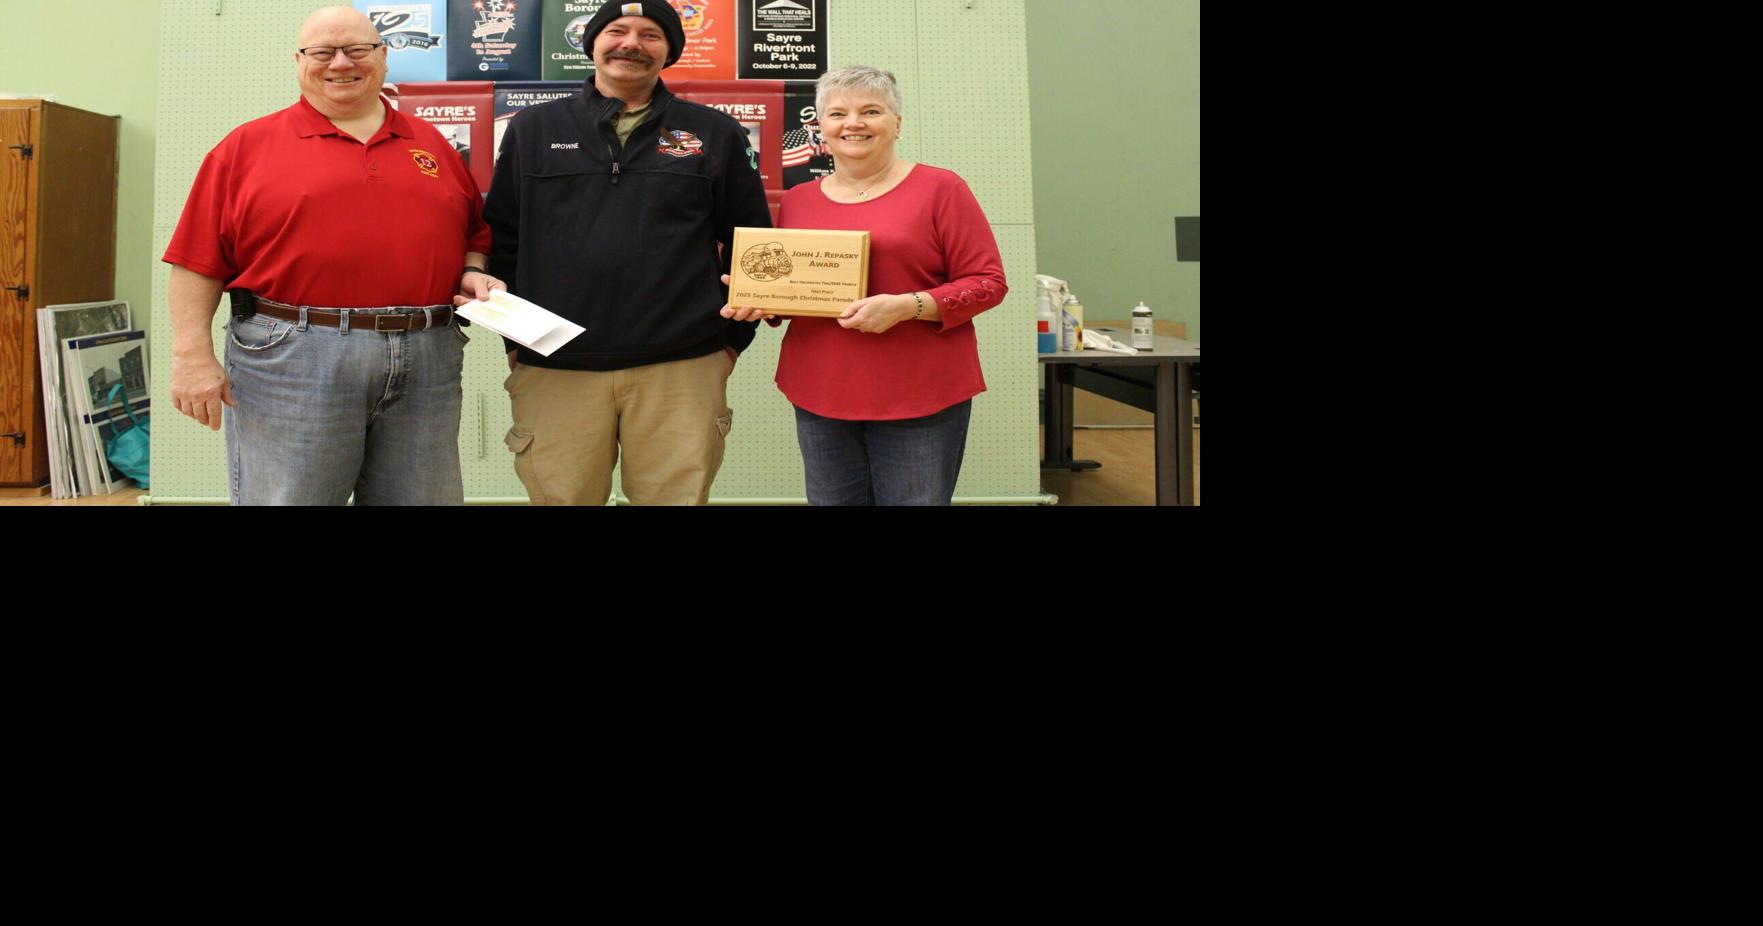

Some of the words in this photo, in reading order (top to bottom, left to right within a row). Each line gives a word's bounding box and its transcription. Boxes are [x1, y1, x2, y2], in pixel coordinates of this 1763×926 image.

[565, 3, 601, 12] Borou
[766, 33, 802, 44] Sayre
[753, 43, 816, 53] Riverfront
[770, 52, 799, 61] Park
[413, 106, 476, 116] SAYRE'S
[705, 103, 766, 115] AYRE'S
[809, 260, 840, 269] AWARD
